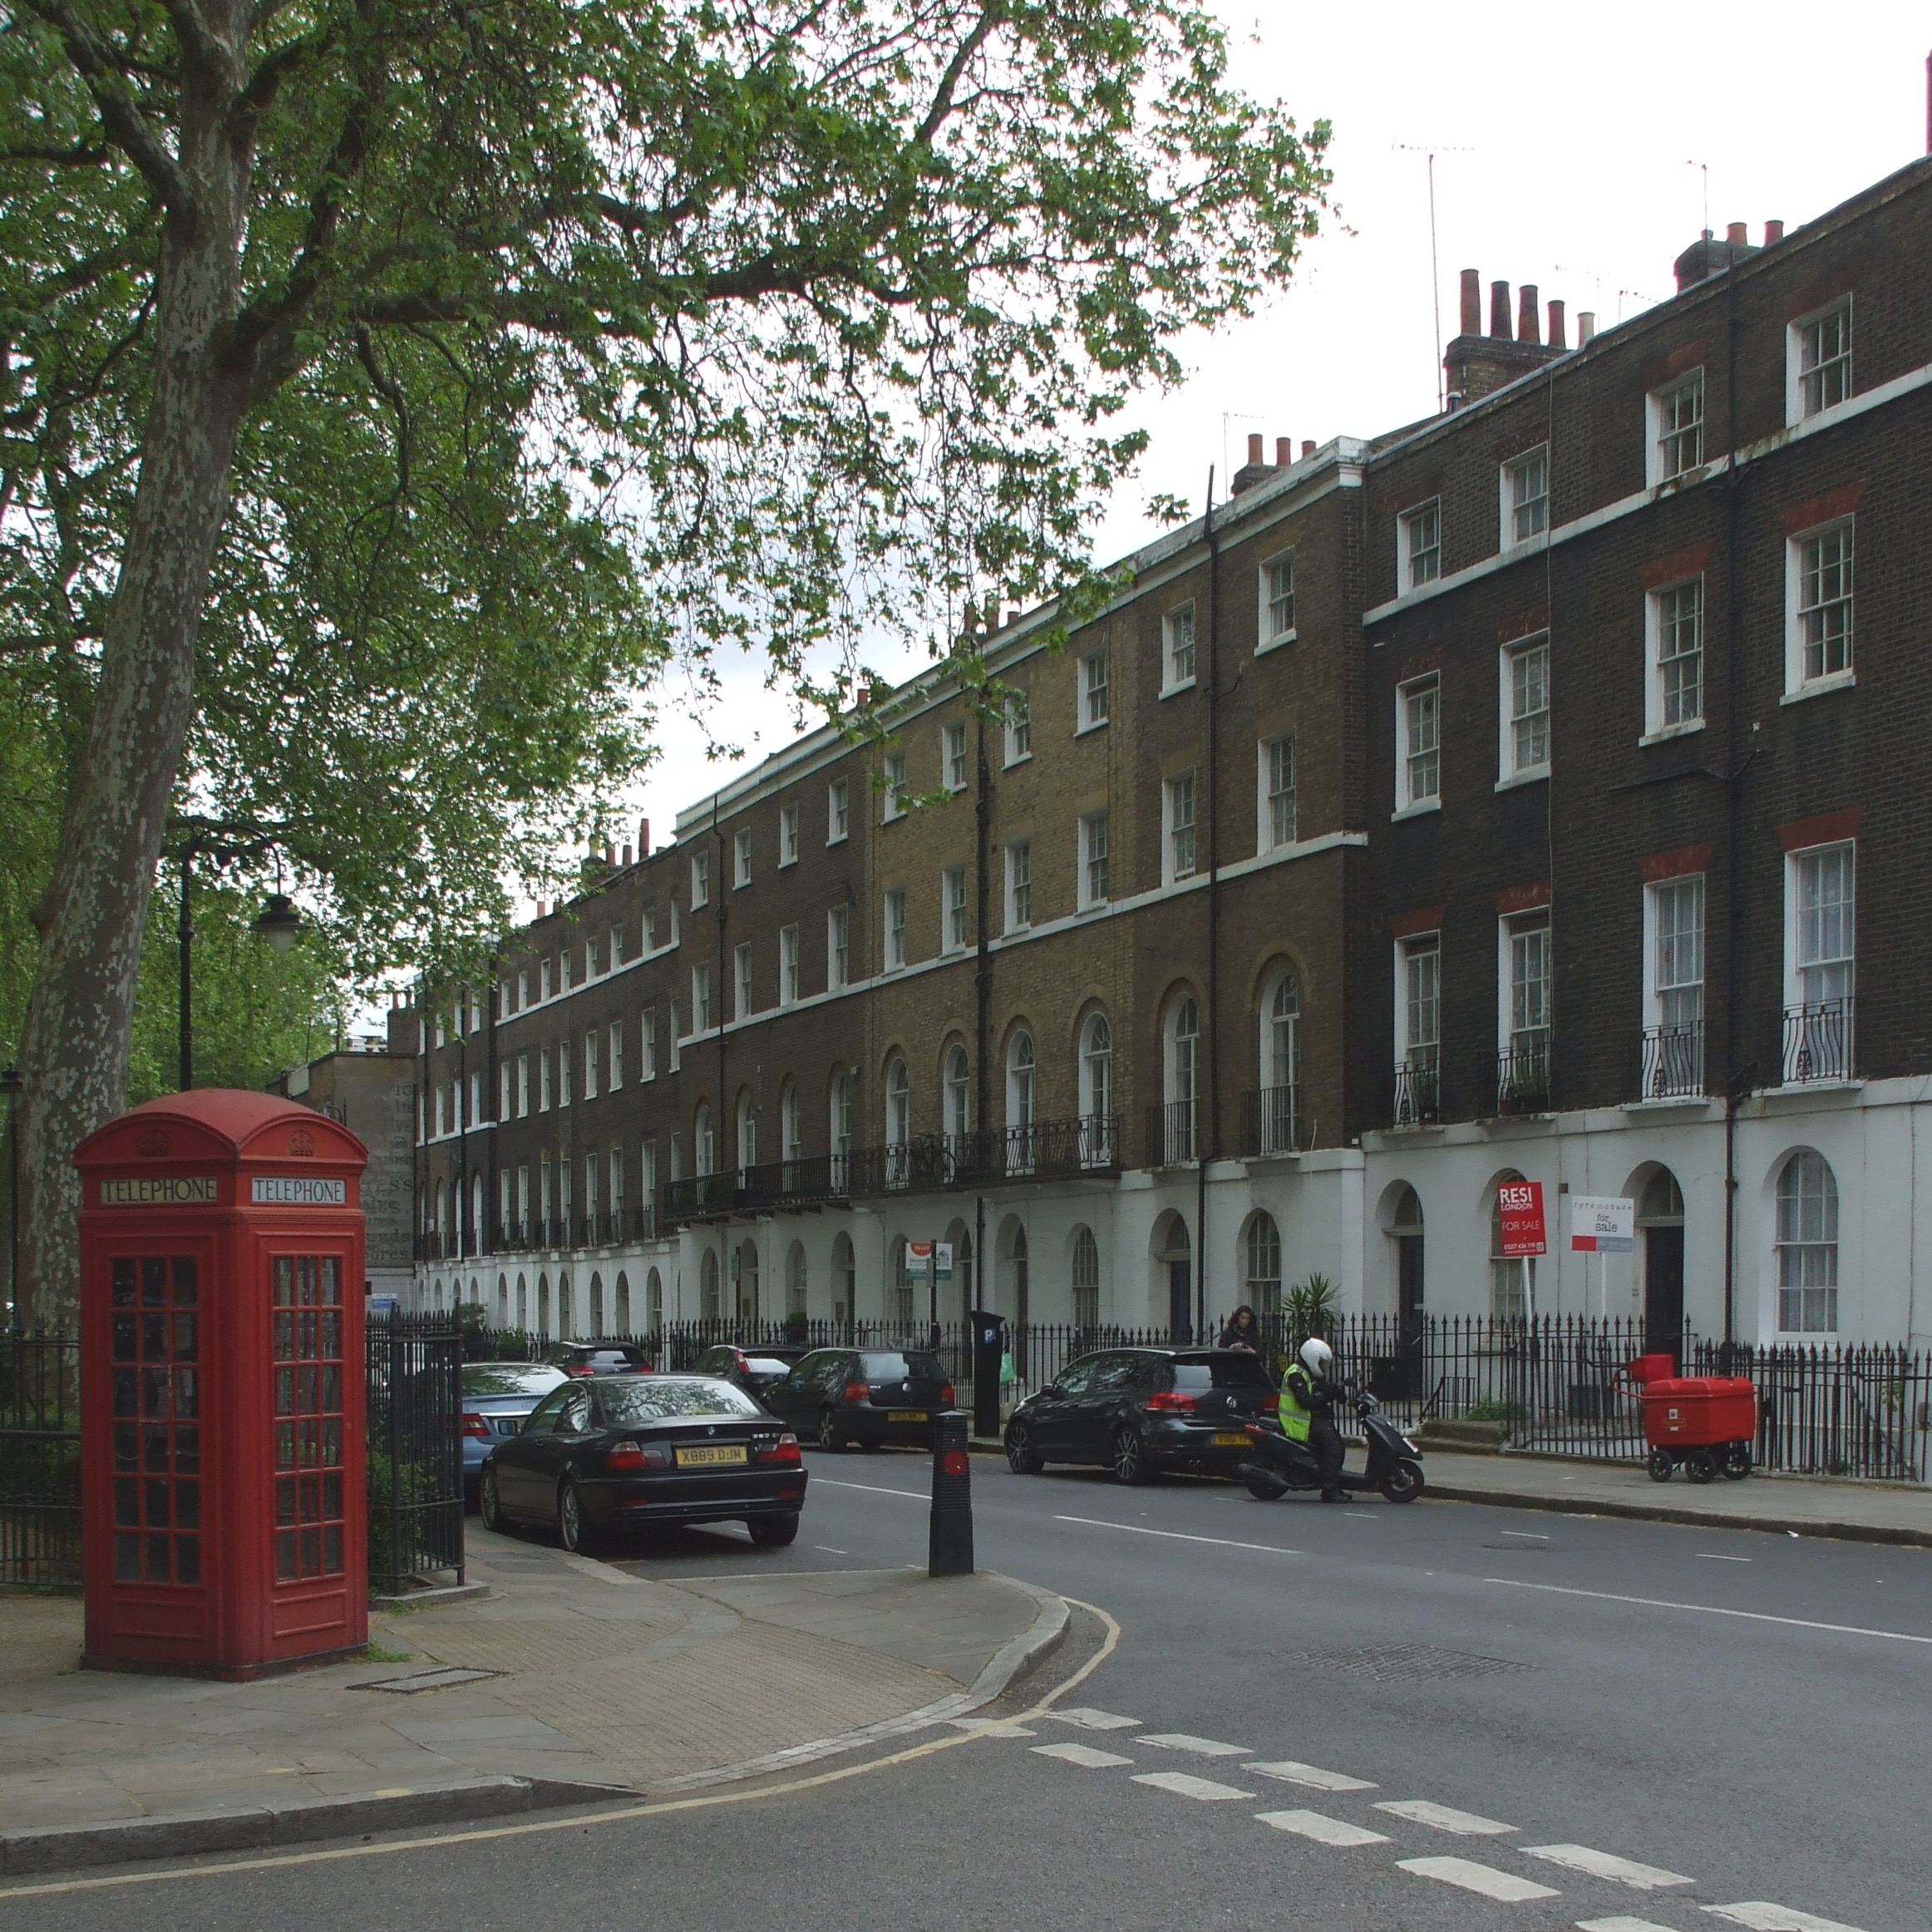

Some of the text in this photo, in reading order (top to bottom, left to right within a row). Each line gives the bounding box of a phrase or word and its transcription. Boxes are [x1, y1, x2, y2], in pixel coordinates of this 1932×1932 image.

[104, 1179, 216, 1203] TELEPHONE
[254, 1179, 343, 1202] TELEPHONE
[1499, 1187, 1532, 1204] RESI
[1501, 1203, 1533, 1211] LONDON
[1596, 1214, 1609, 1222] for
[1501, 1220, 1540, 1230] FOR SALE
[1594, 1222, 1618, 1232] sale
